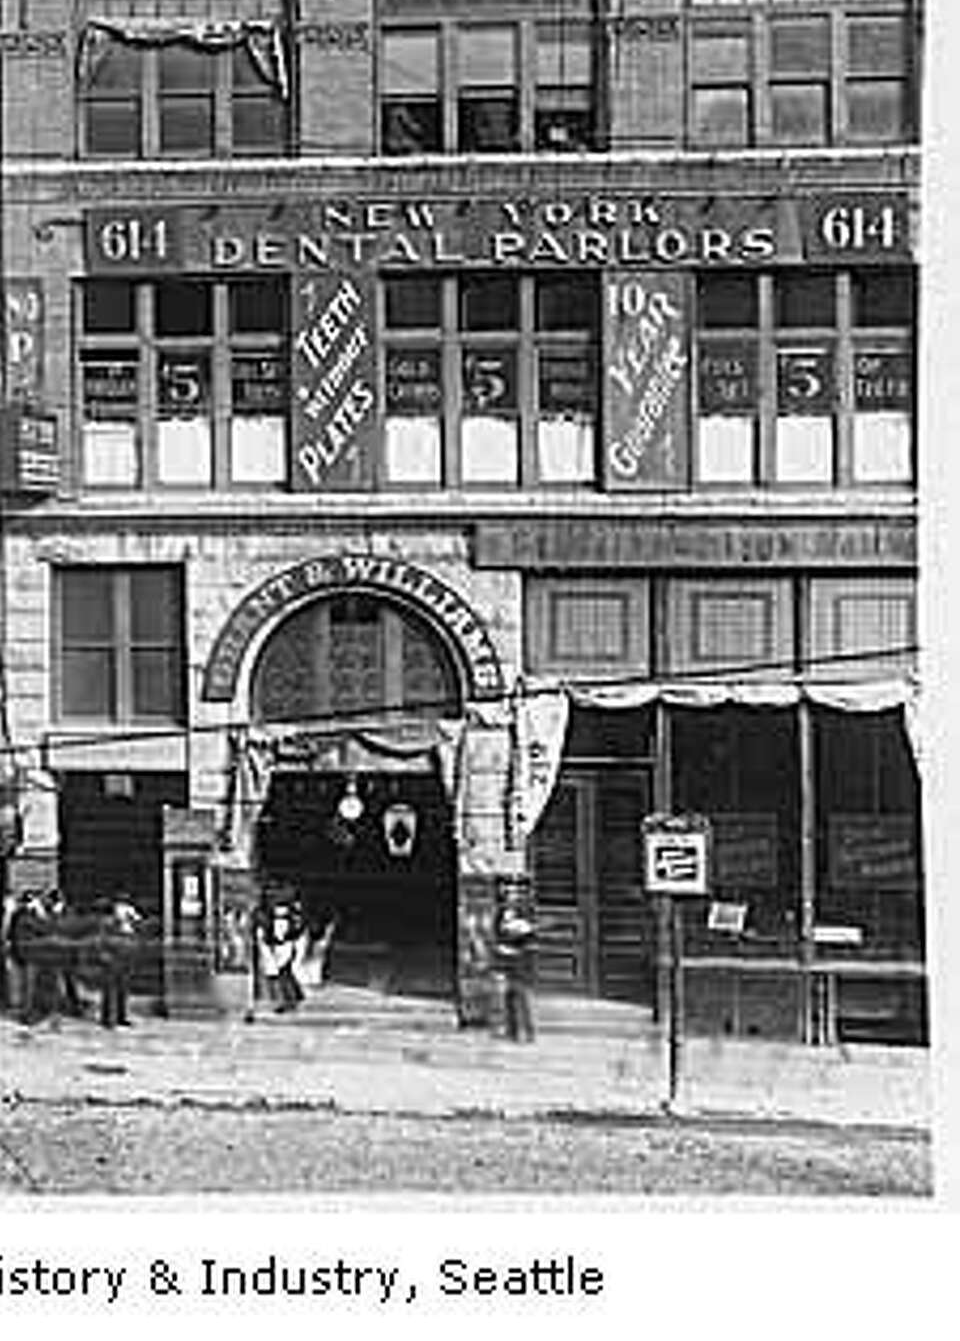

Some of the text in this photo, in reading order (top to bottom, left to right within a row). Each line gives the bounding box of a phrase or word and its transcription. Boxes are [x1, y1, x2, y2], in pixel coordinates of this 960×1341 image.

[325, 200, 661, 229] NEW YORK
[822, 206, 896, 249] 614
[101, 219, 167, 260] 614
[214, 228, 775, 267] DENTAL PARLORS
[608, 284, 644, 316] 10
[295, 279, 362, 368] TEETH
[608, 292, 682, 395] YEAR
[298, 379, 374, 485] PLATES
[343, 557, 506, 690] WILLIAMS
